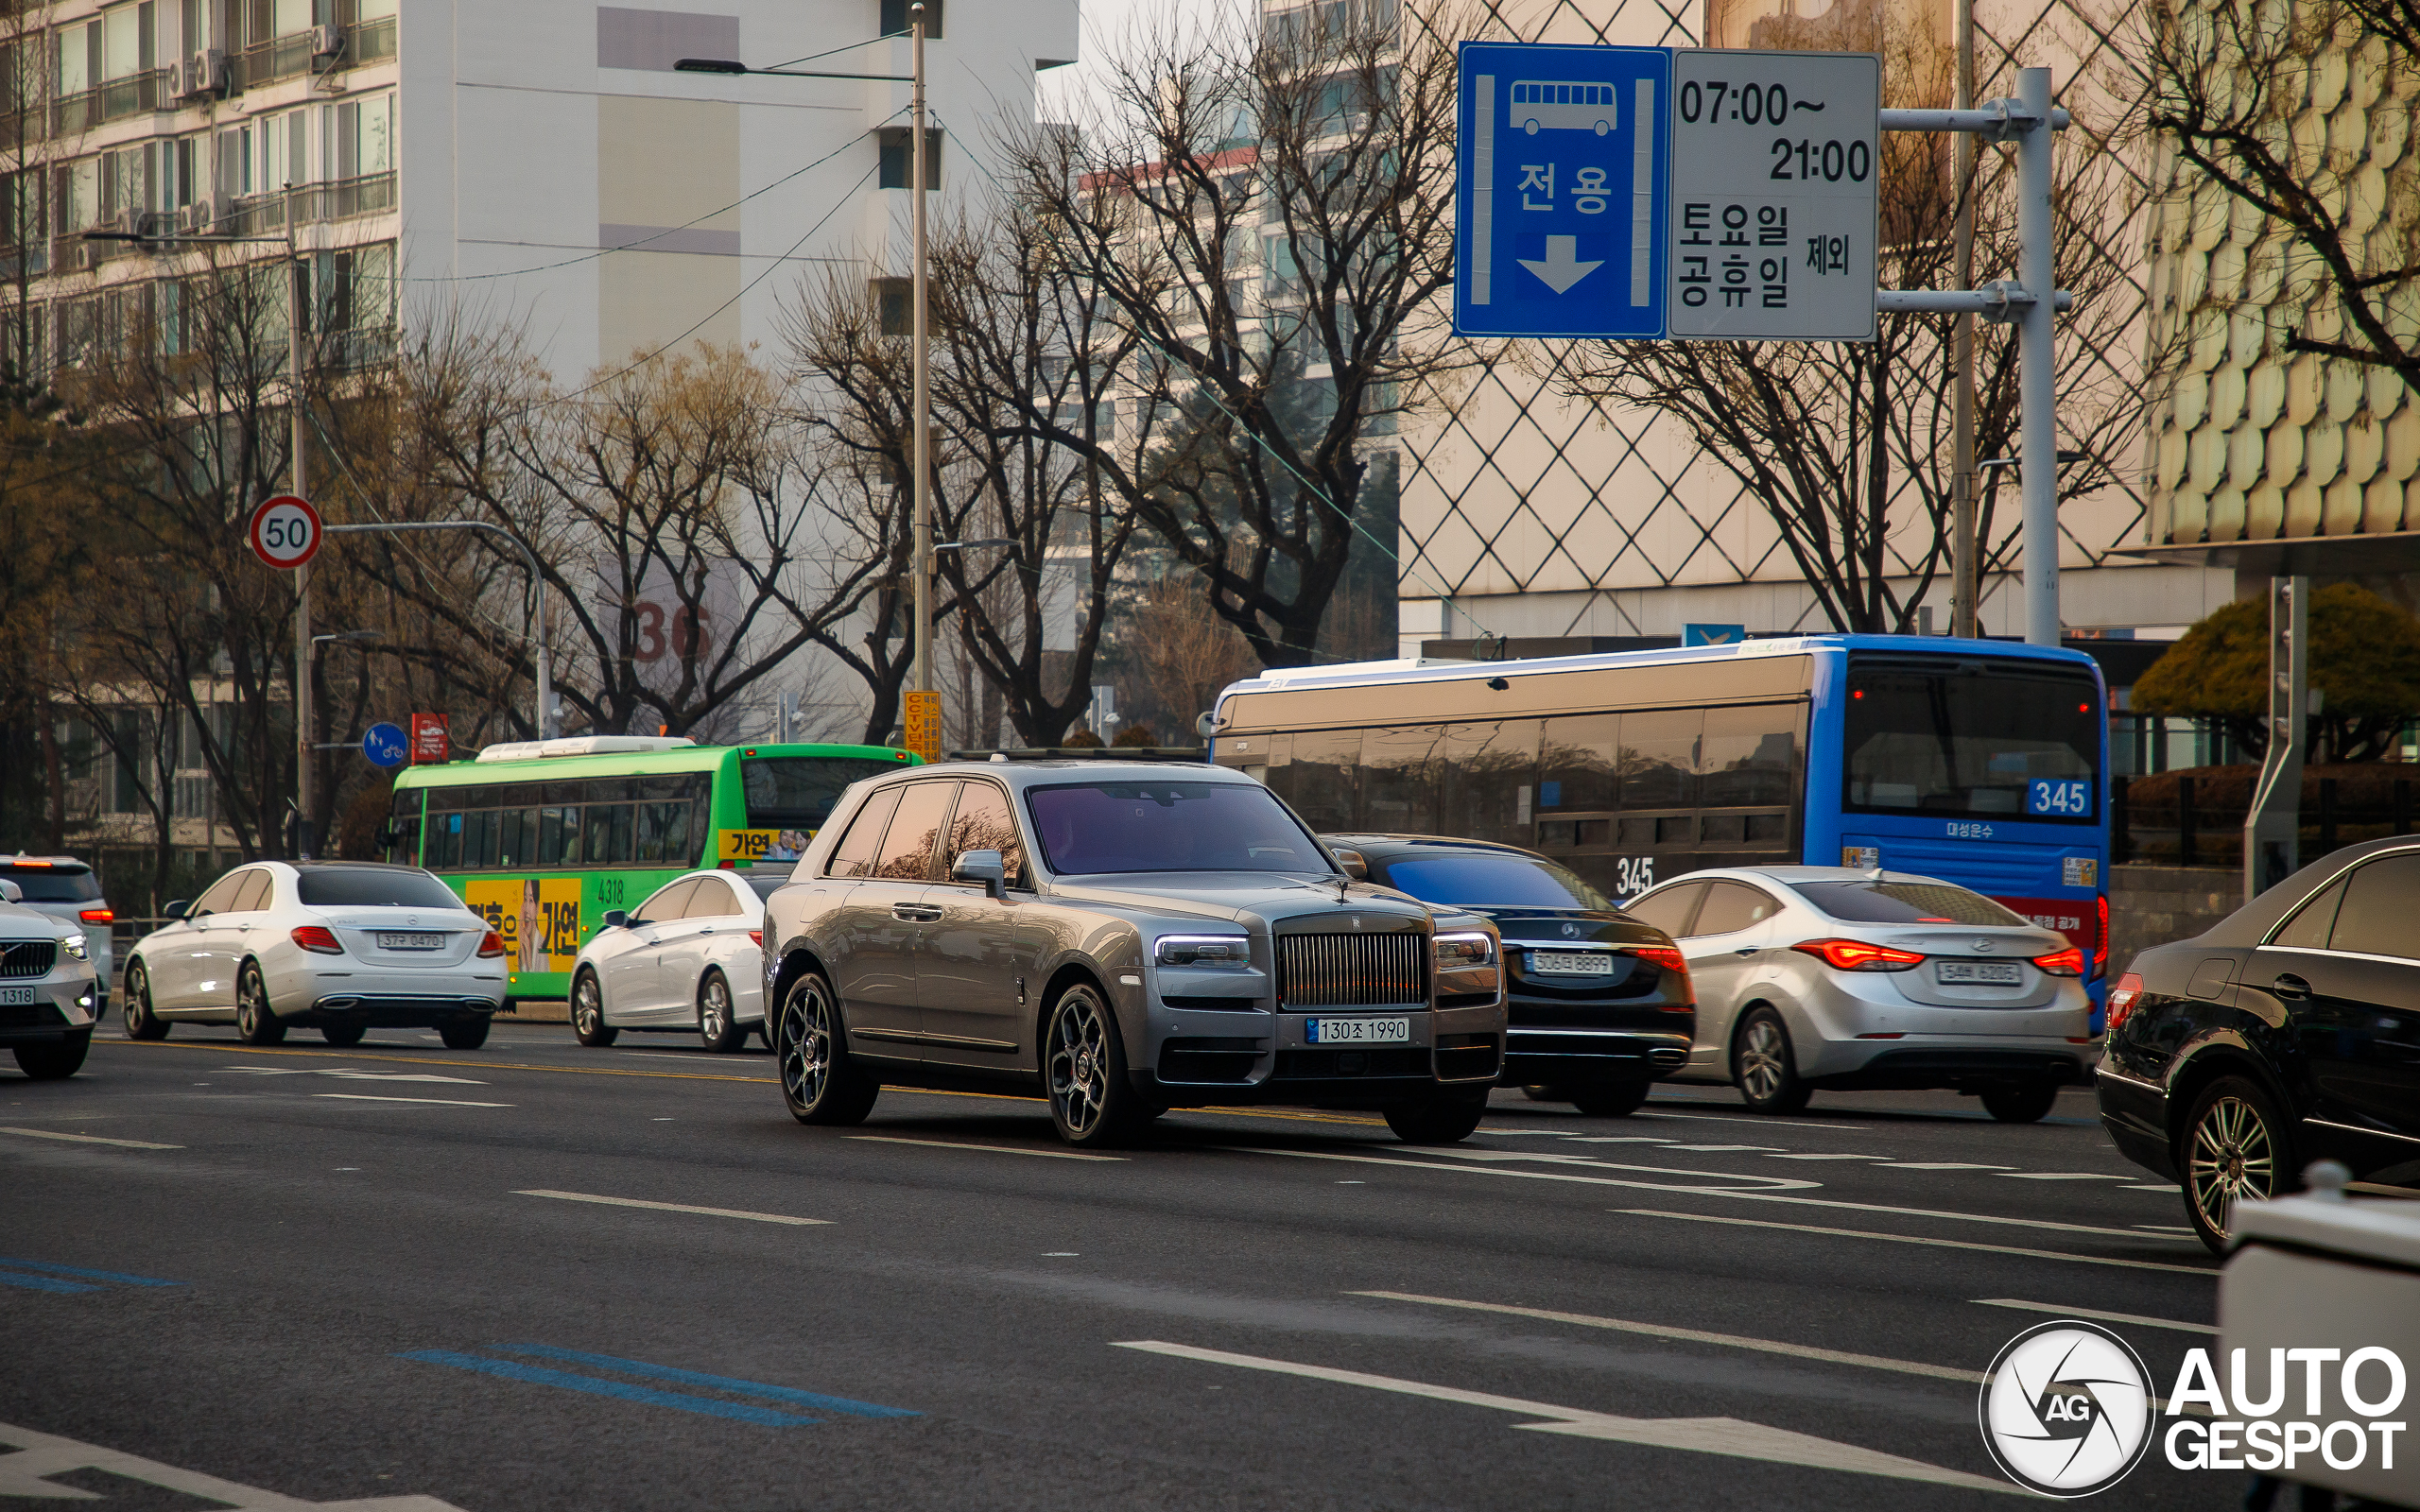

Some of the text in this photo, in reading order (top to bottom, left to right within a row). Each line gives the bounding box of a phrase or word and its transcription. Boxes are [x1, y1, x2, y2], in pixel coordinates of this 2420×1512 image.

[1770, 138, 1871, 182] 21:00
[1680, 203, 1788, 246] 토요일
[1806, 234, 1849, 275] 제외
[1679, 253, 1788, 308] 공휴일
[267, 517, 306, 548] 50
[631, 600, 713, 663] 36
[2035, 782, 2085, 814] 345
[731, 833, 770, 856] 가연
[1946, 822, 1994, 839] 대성운수
[1616, 856, 1654, 895] 345
[597, 878, 624, 905] 4318
[410, 935, 440, 947] 0470
[539, 901, 579, 956] 가연
[1575, 956, 1608, 971] 8899
[1, 988, 33, 1004] 1318
[1322, 1022, 1406, 1040] 130조 1990
